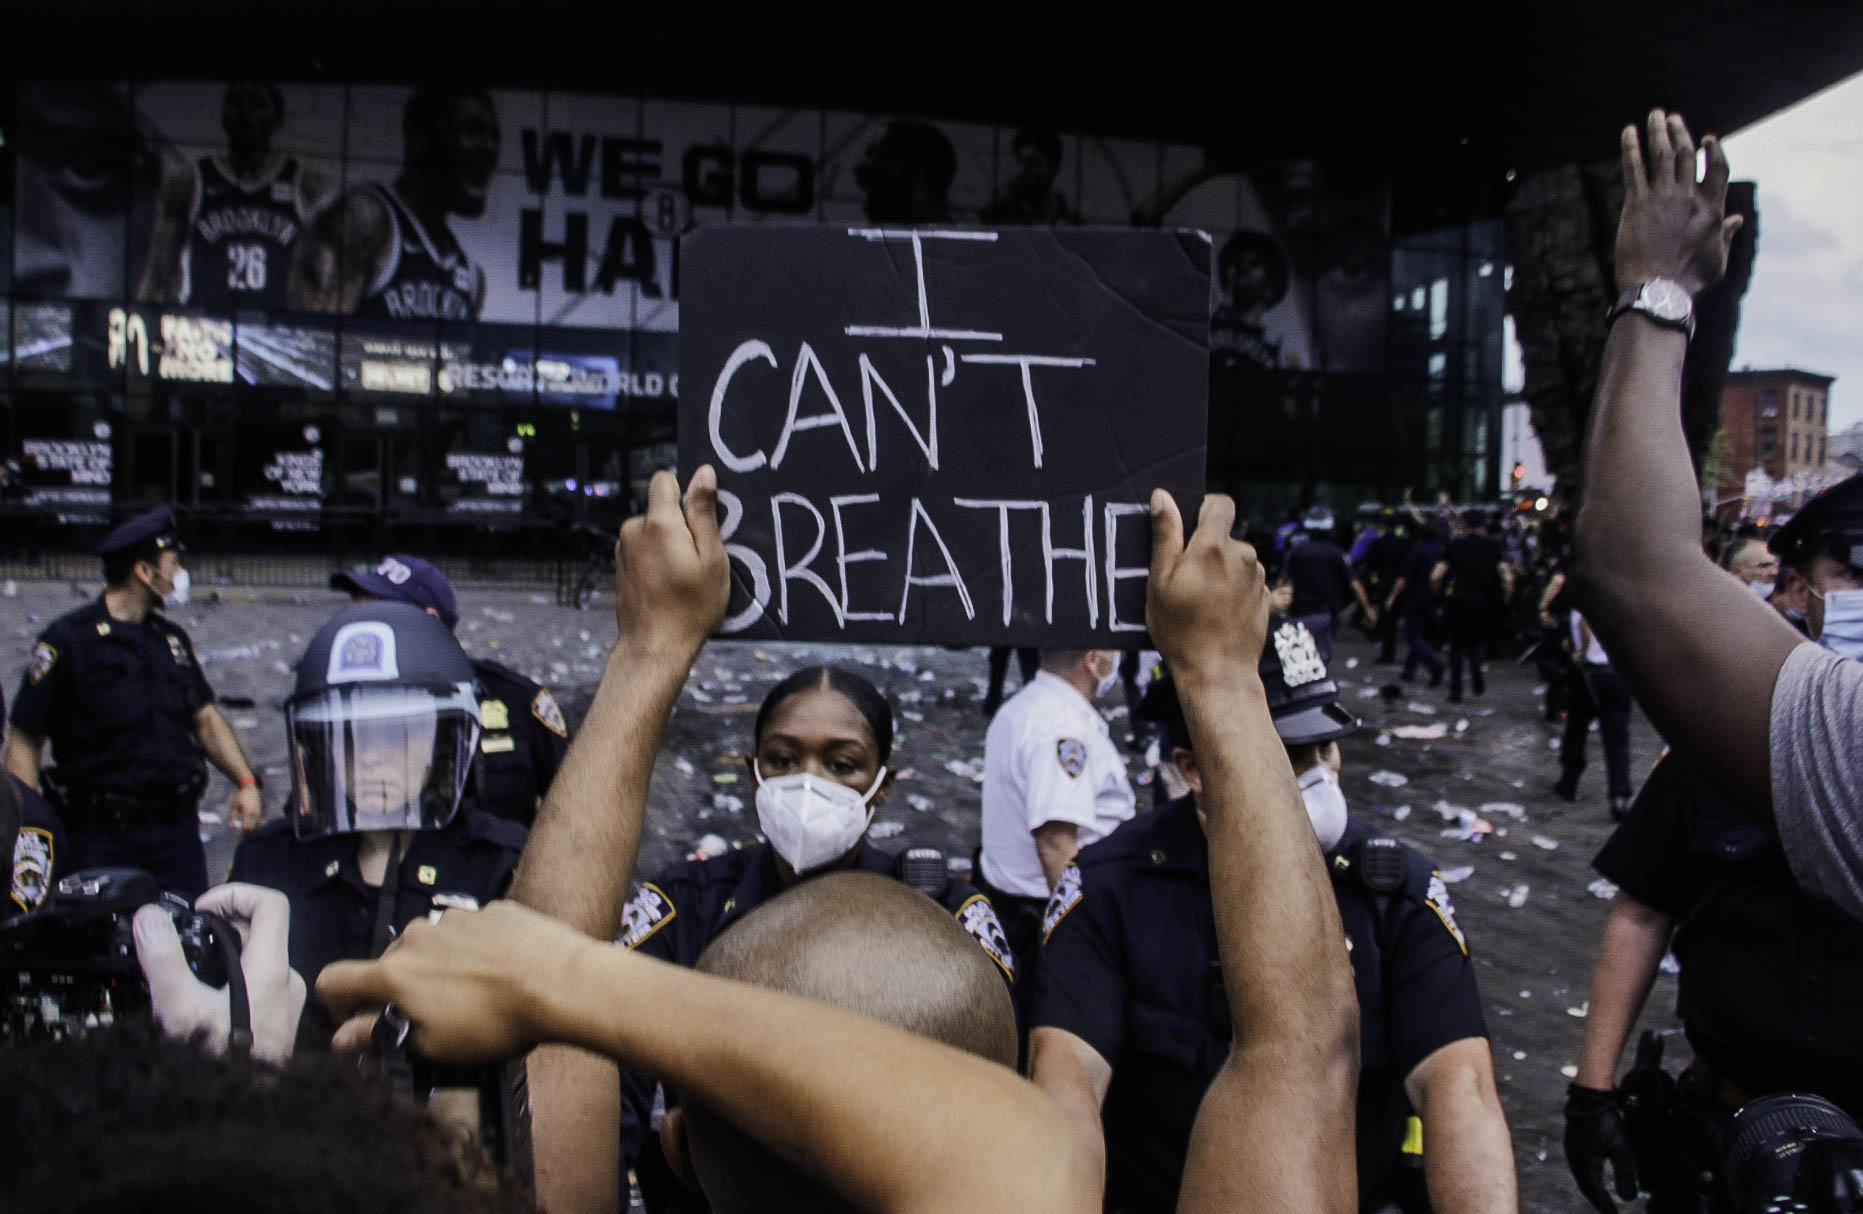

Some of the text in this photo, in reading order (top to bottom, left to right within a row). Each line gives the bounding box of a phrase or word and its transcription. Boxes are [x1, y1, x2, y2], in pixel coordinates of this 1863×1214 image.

[521, 129, 815, 213] WE GO
[227, 243, 266, 291] 26
[518, 210, 679, 299] HA
[845, 227, 1003, 342] I
[708, 337, 1096, 473] CAN'T
[717, 489, 1150, 634] BREATHE
